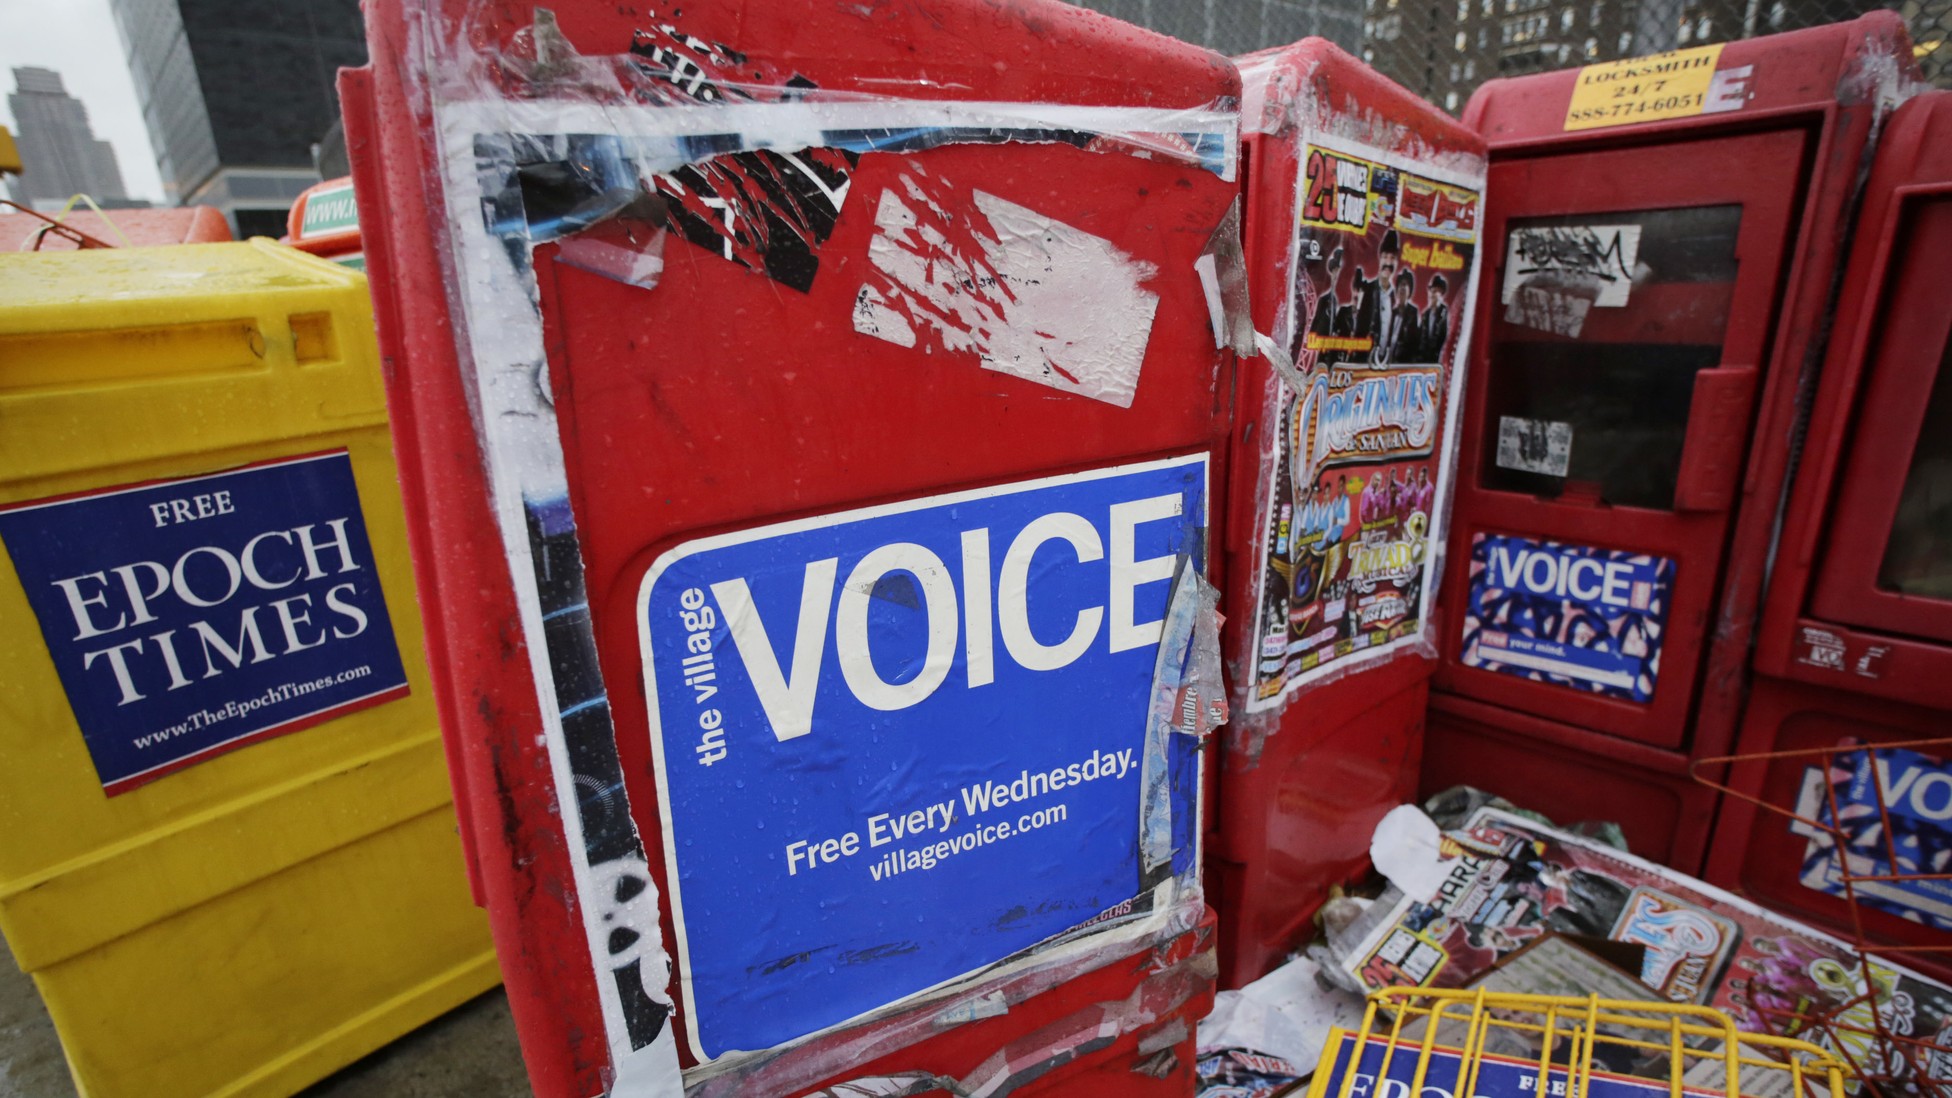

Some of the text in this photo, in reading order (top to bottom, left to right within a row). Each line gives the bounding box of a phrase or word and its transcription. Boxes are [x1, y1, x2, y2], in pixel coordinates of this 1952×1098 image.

[1585, 54, 1711, 85] LOCKSMITH
[1613, 80, 1667, 98] 24/7
[1303, 149, 1338, 224] 25
[1330, 370, 1352, 388] LOS
[150, 490, 235, 528] FREE
[51, 517, 361, 642] EPOCH
[1498, 546, 1634, 607] VOICE
[84, 582, 368, 707] TIMES
[710, 491, 1183, 743] VOICE
[133, 664, 372, 750] www.TheEpochTimes.com
[679, 587, 728, 767] the village
[785, 746, 1137, 876] Free Every Wednesday.
[869, 802, 1067, 882] villagevoice.com
